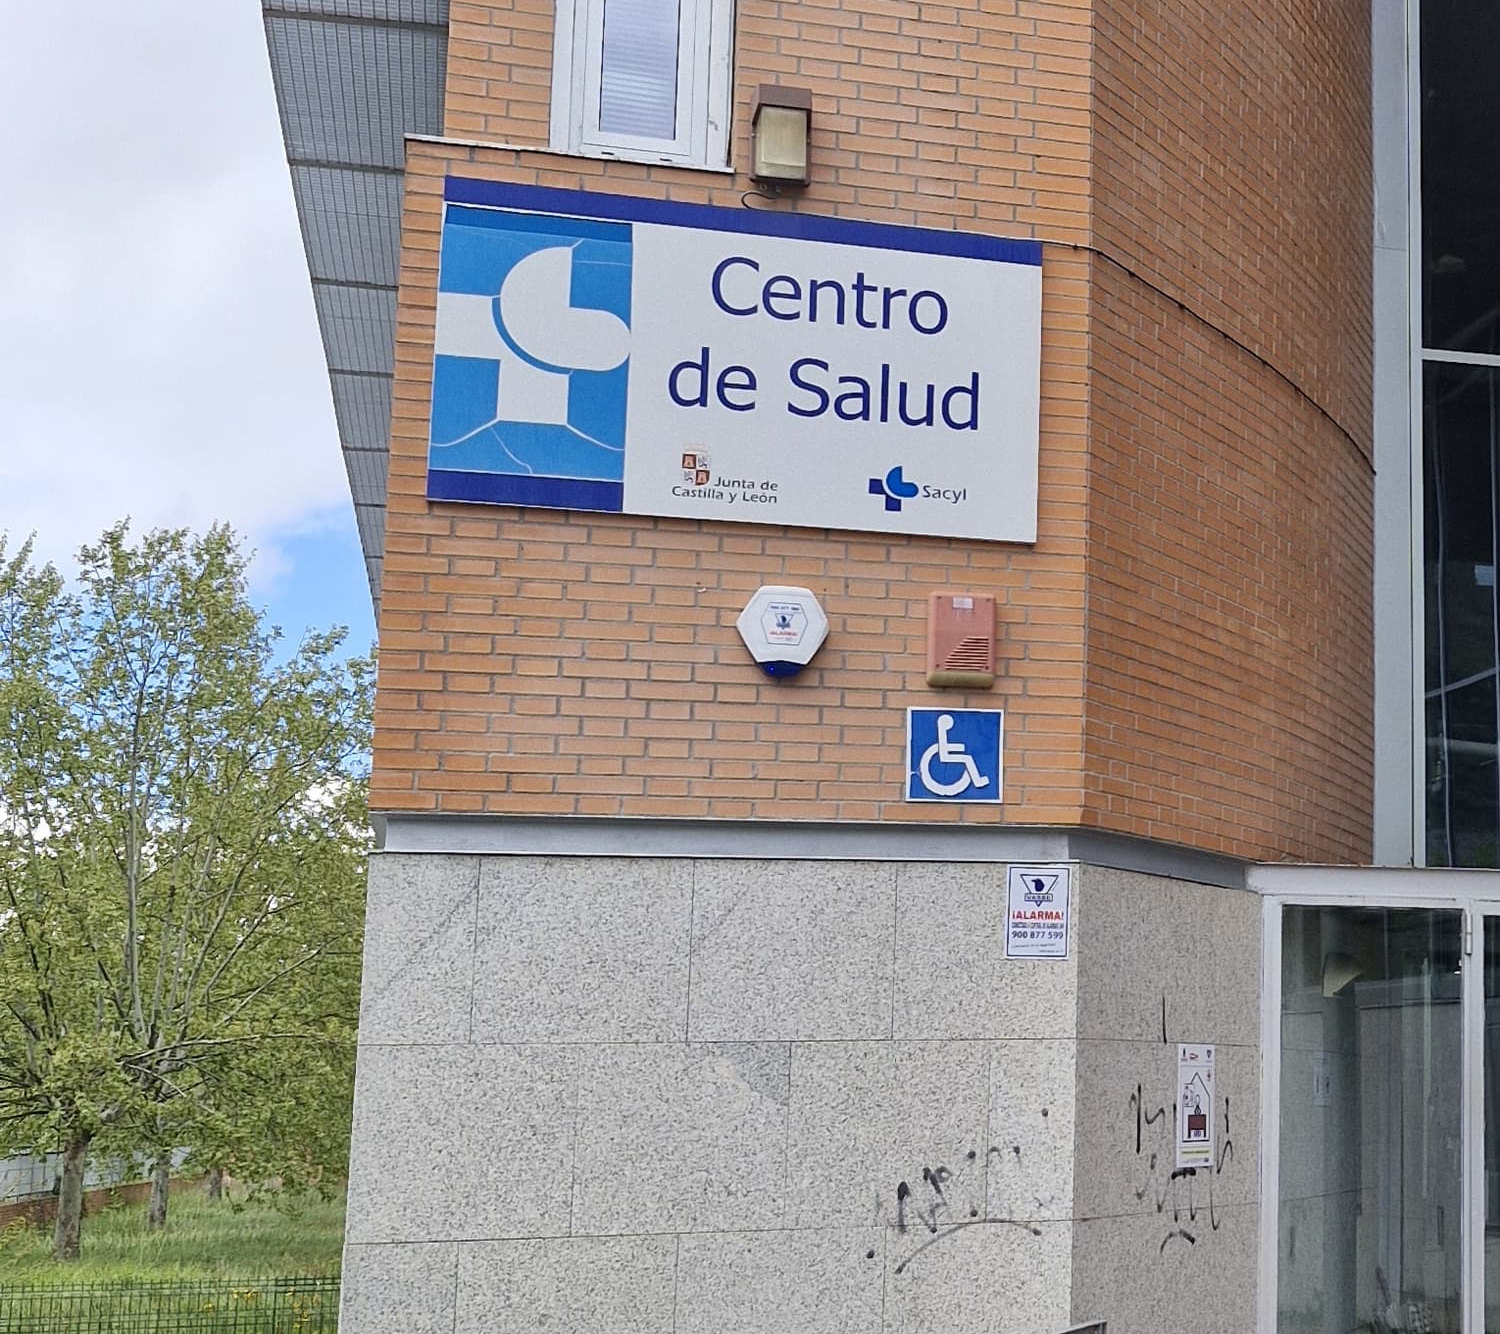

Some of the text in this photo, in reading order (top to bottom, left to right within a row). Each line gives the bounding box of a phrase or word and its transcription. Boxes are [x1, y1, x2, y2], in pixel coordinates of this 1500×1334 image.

[711, 255, 949, 335] Centro
[668, 346, 980, 431] de Salud
[713, 475, 779, 492] Junta de
[671, 485, 778, 504] Castilla y León
[922, 484, 967, 505] Sacyl
[1012, 911, 1064, 920] ¡ALARMA!
[1012, 930, 1064, 940] 900 877 599
